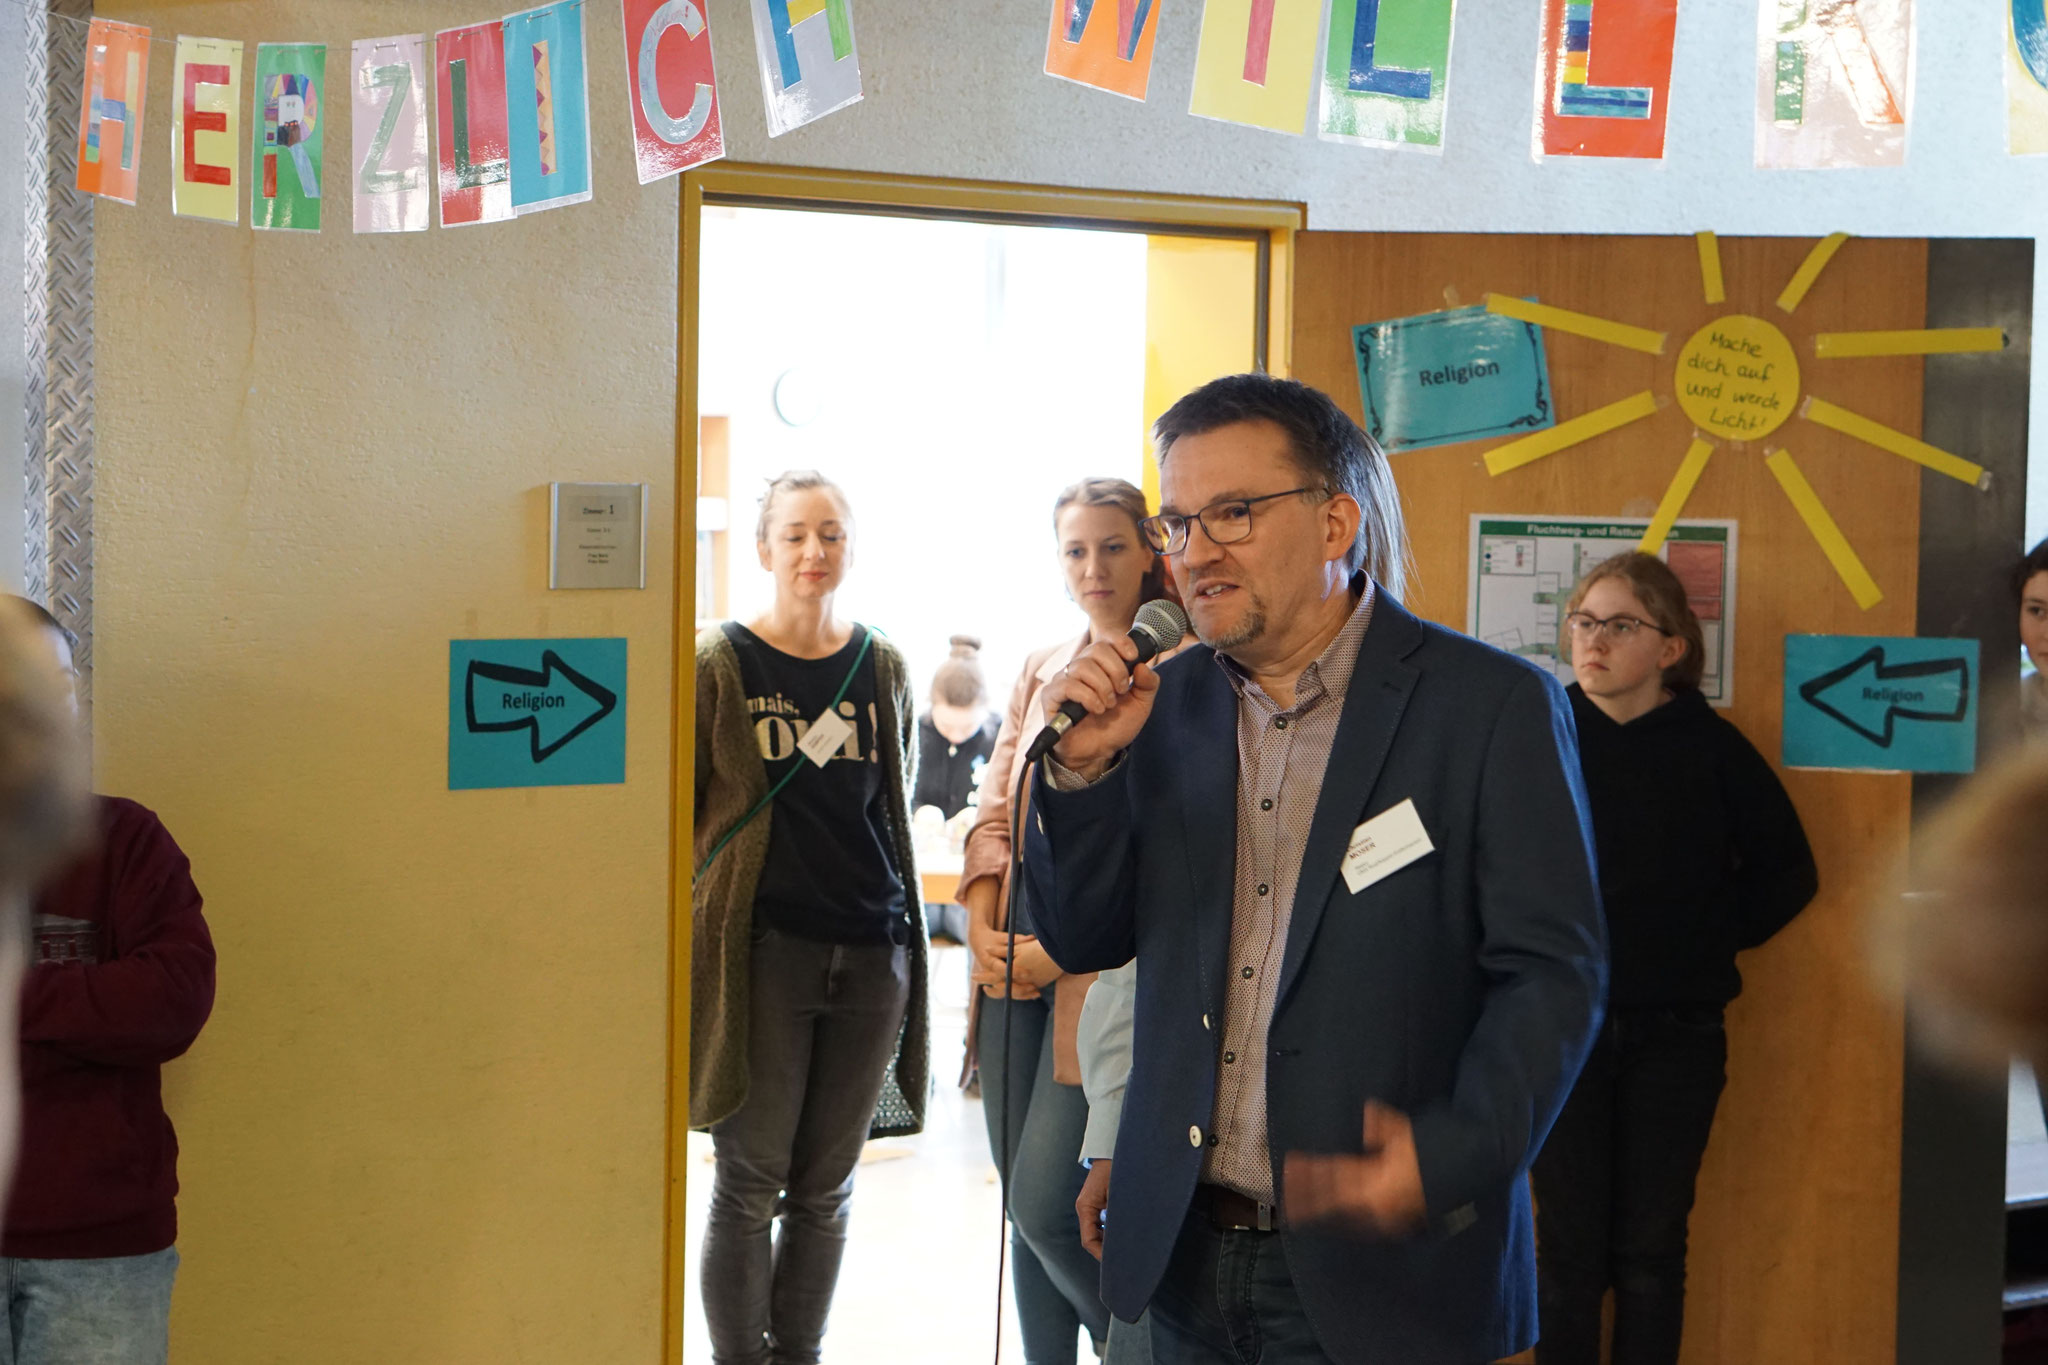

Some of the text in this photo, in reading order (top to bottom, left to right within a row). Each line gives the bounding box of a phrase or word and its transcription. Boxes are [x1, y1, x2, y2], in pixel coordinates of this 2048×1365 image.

[1709, 332, 1762, 358] Mache
[1418, 361, 1500, 386] Religion
[1687, 353, 1774, 382] dich auf
[1732, 391, 1780, 410] werde
[1709, 407, 1766, 430] Licht!
[1526, 523, 1584, 537] Fluchtweg-
[1587, 526, 1607, 536] und
[502, 692, 565, 712] Religion
[1862, 687, 1924, 703] Religion
